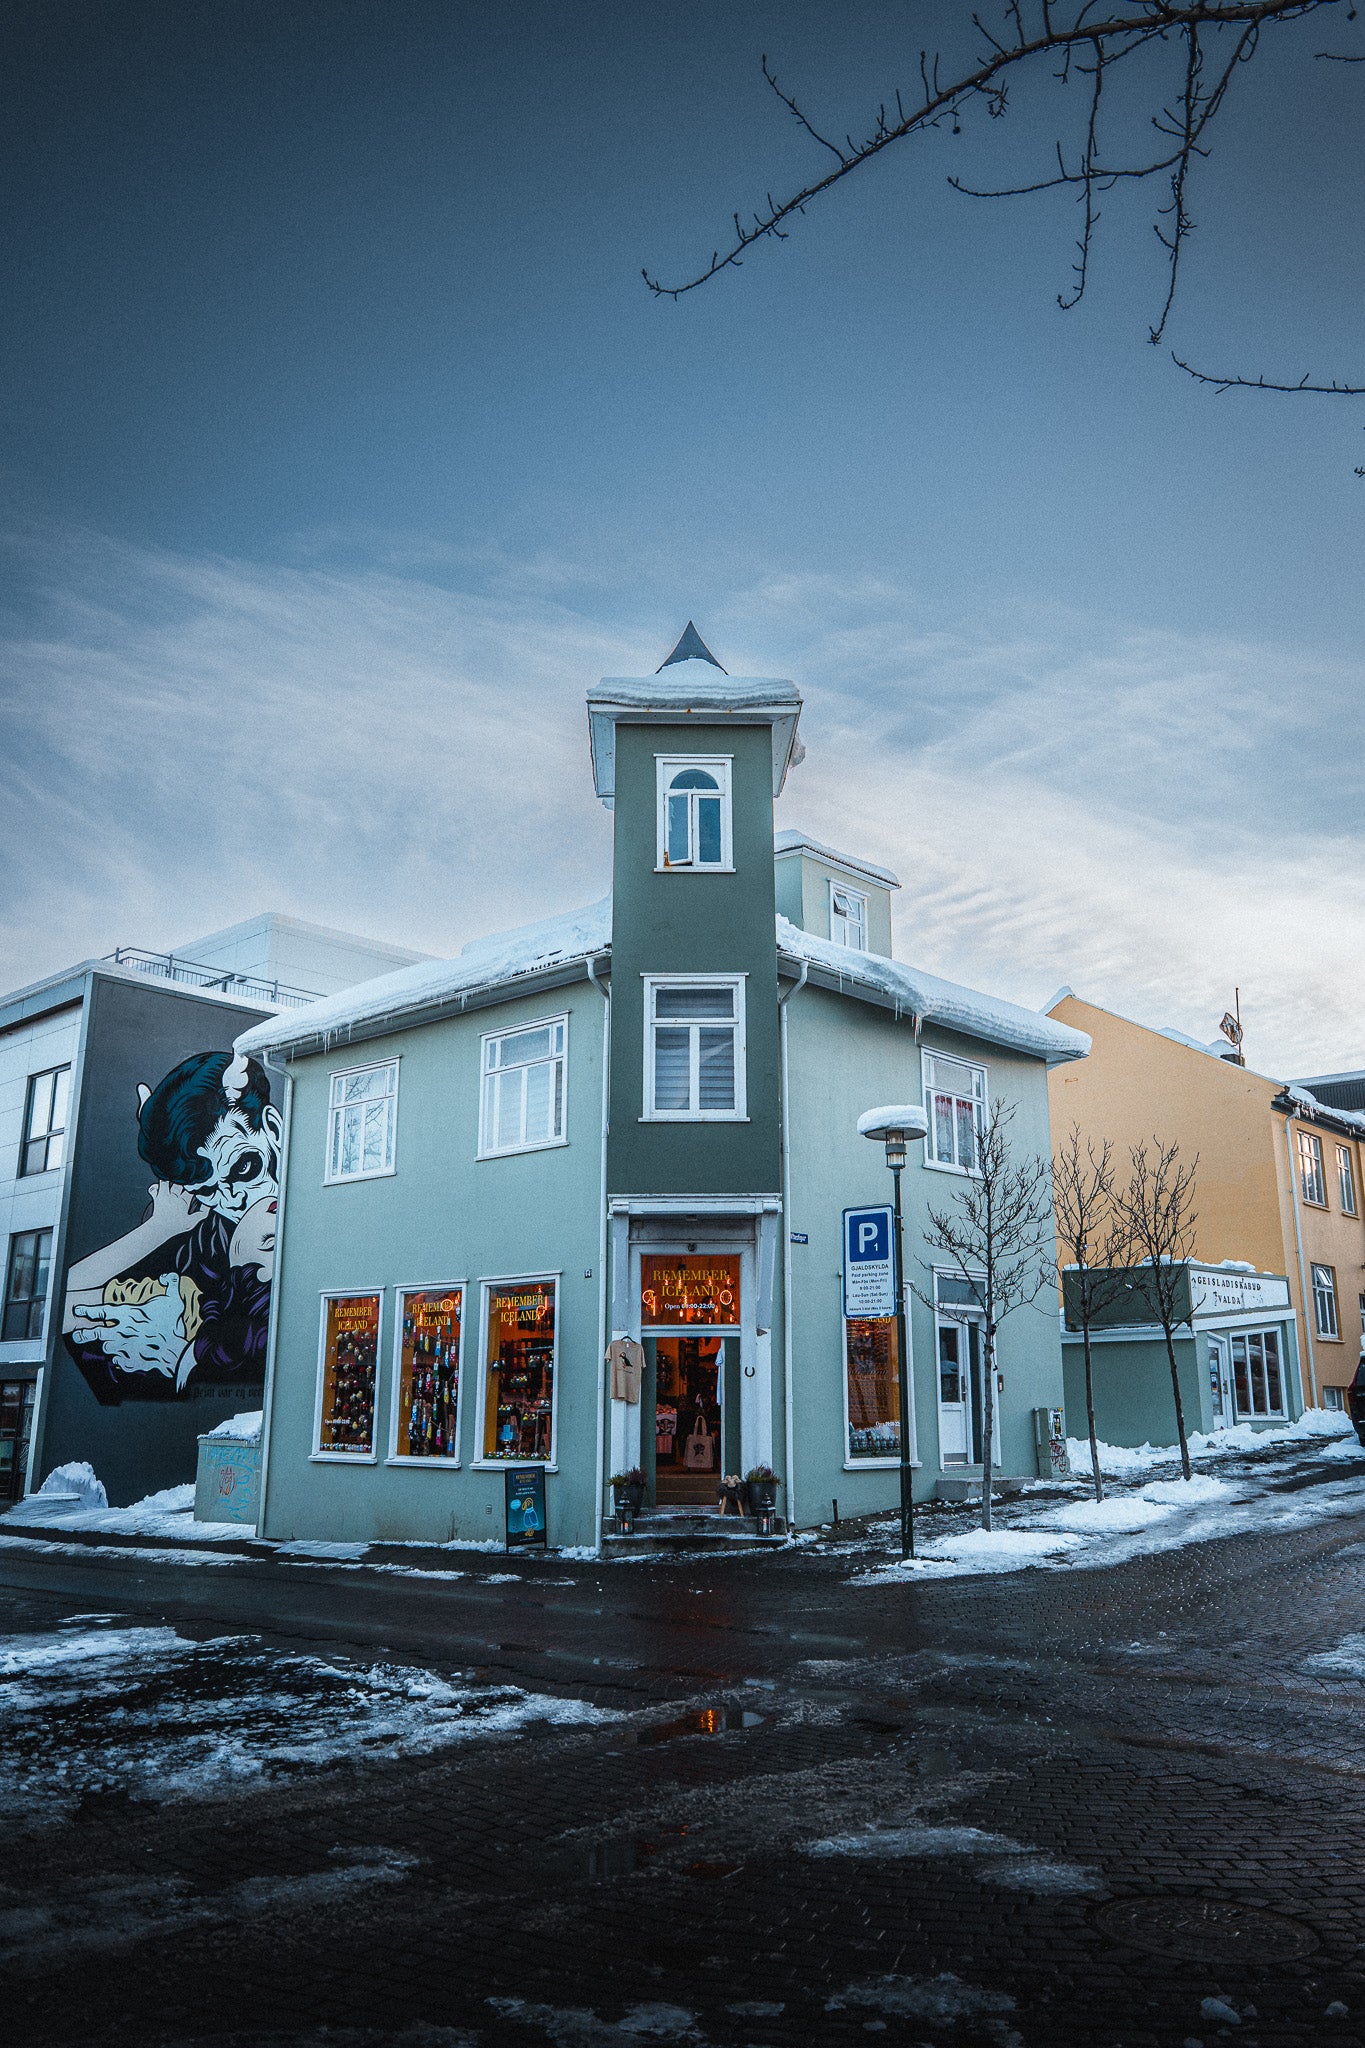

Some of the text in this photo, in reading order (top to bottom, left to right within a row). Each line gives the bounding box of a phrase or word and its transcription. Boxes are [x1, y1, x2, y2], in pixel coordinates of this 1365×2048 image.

[859, 1222, 878, 1253] P
[653, 1270, 728, 1280] REMEMBER
[662, 1286, 720, 1296] ICELAND
[496, 1295, 544, 1308] REMEMBER
[335, 1306, 372, 1318] REMEMBER
[501, 1310, 539, 1322] ICELAND
[338, 1320, 368, 1330] ICELAND
[416, 1316, 448, 1326] IELAND
